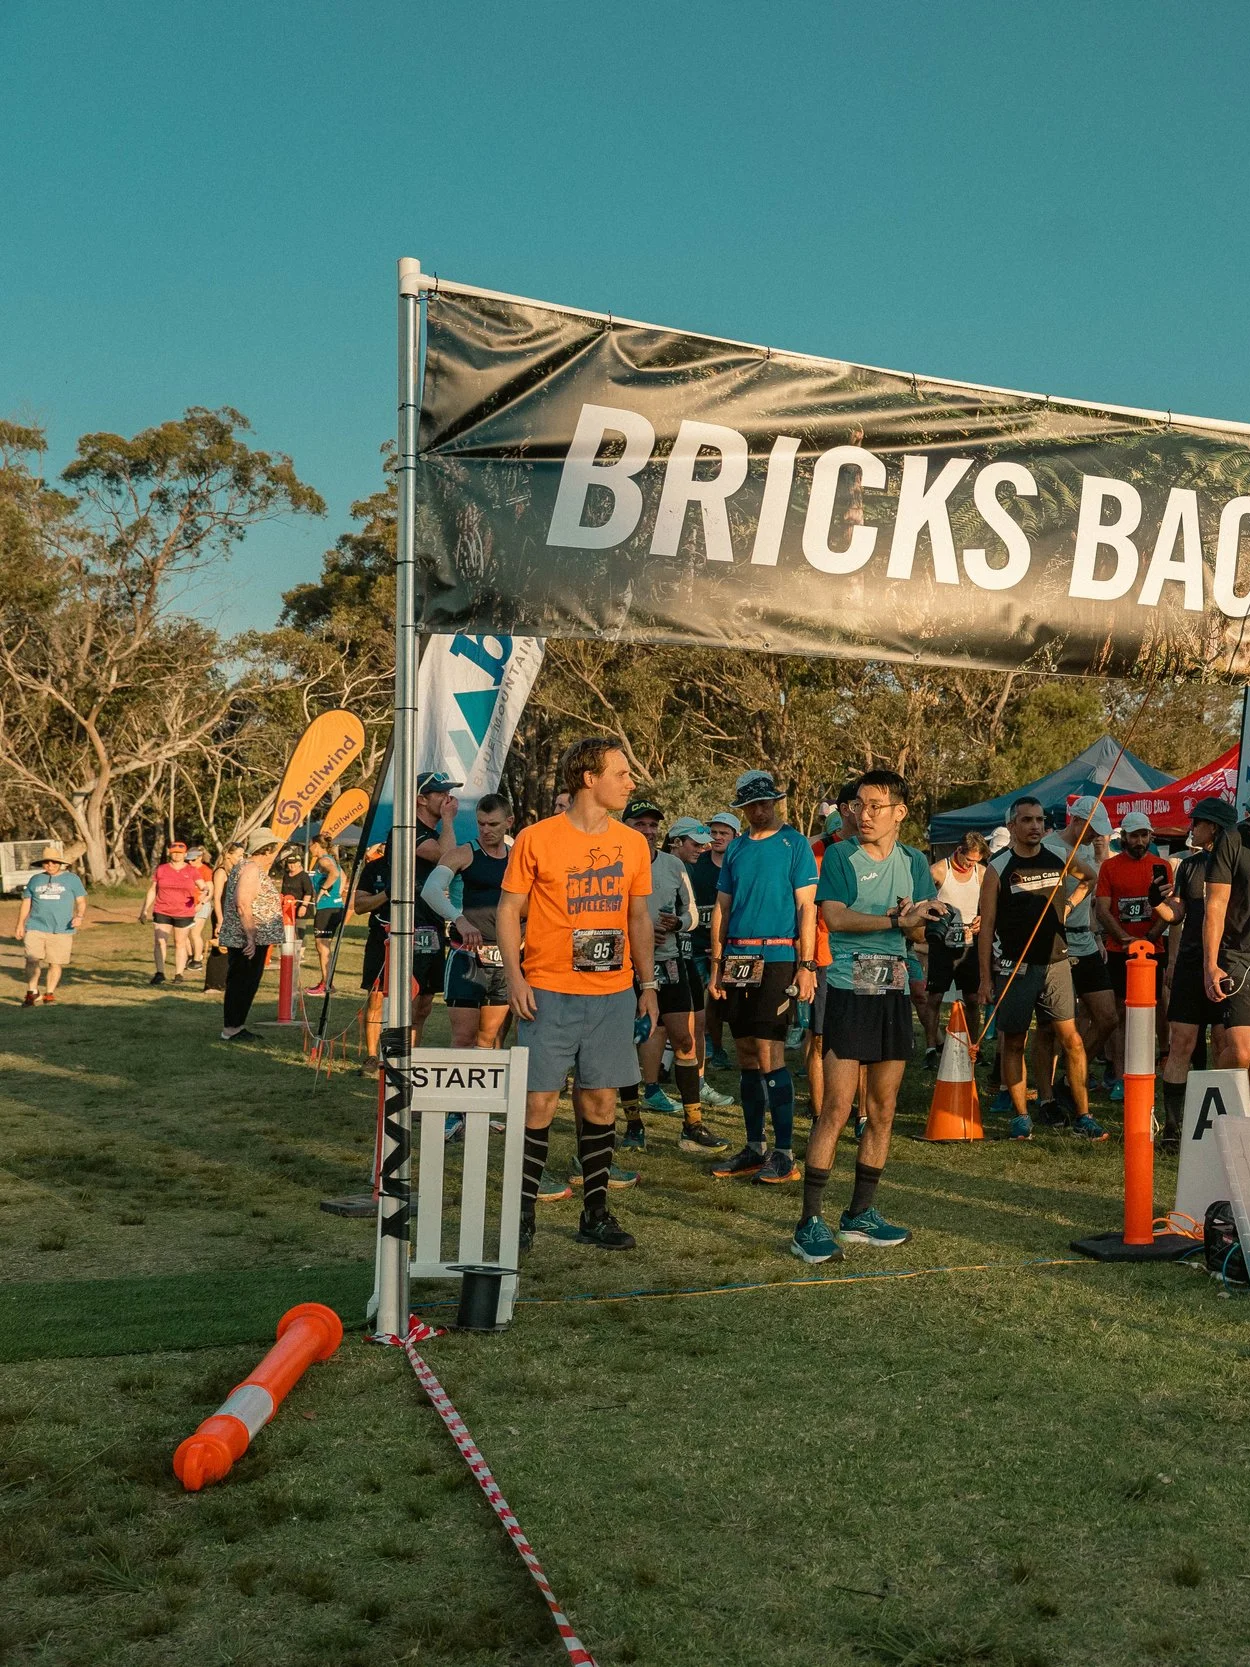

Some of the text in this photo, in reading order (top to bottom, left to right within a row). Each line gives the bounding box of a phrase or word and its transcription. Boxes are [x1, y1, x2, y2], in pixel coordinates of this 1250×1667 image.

[546, 403, 1038, 591] BRICKS
[297, 734, 357, 801] tailwind
[329, 802, 365, 833] tailwind
[1023, 870, 1060, 882] Team Casa
[568, 876, 623, 899] BEACH
[1129, 904, 1141, 915] 39
[420, 935, 429, 947] 14
[953, 932, 962, 941] 31
[593, 942, 611, 959] 95
[736, 965, 750, 978] 70
[873, 966, 889, 982] 77
[411, 1067, 504, 1089] START
